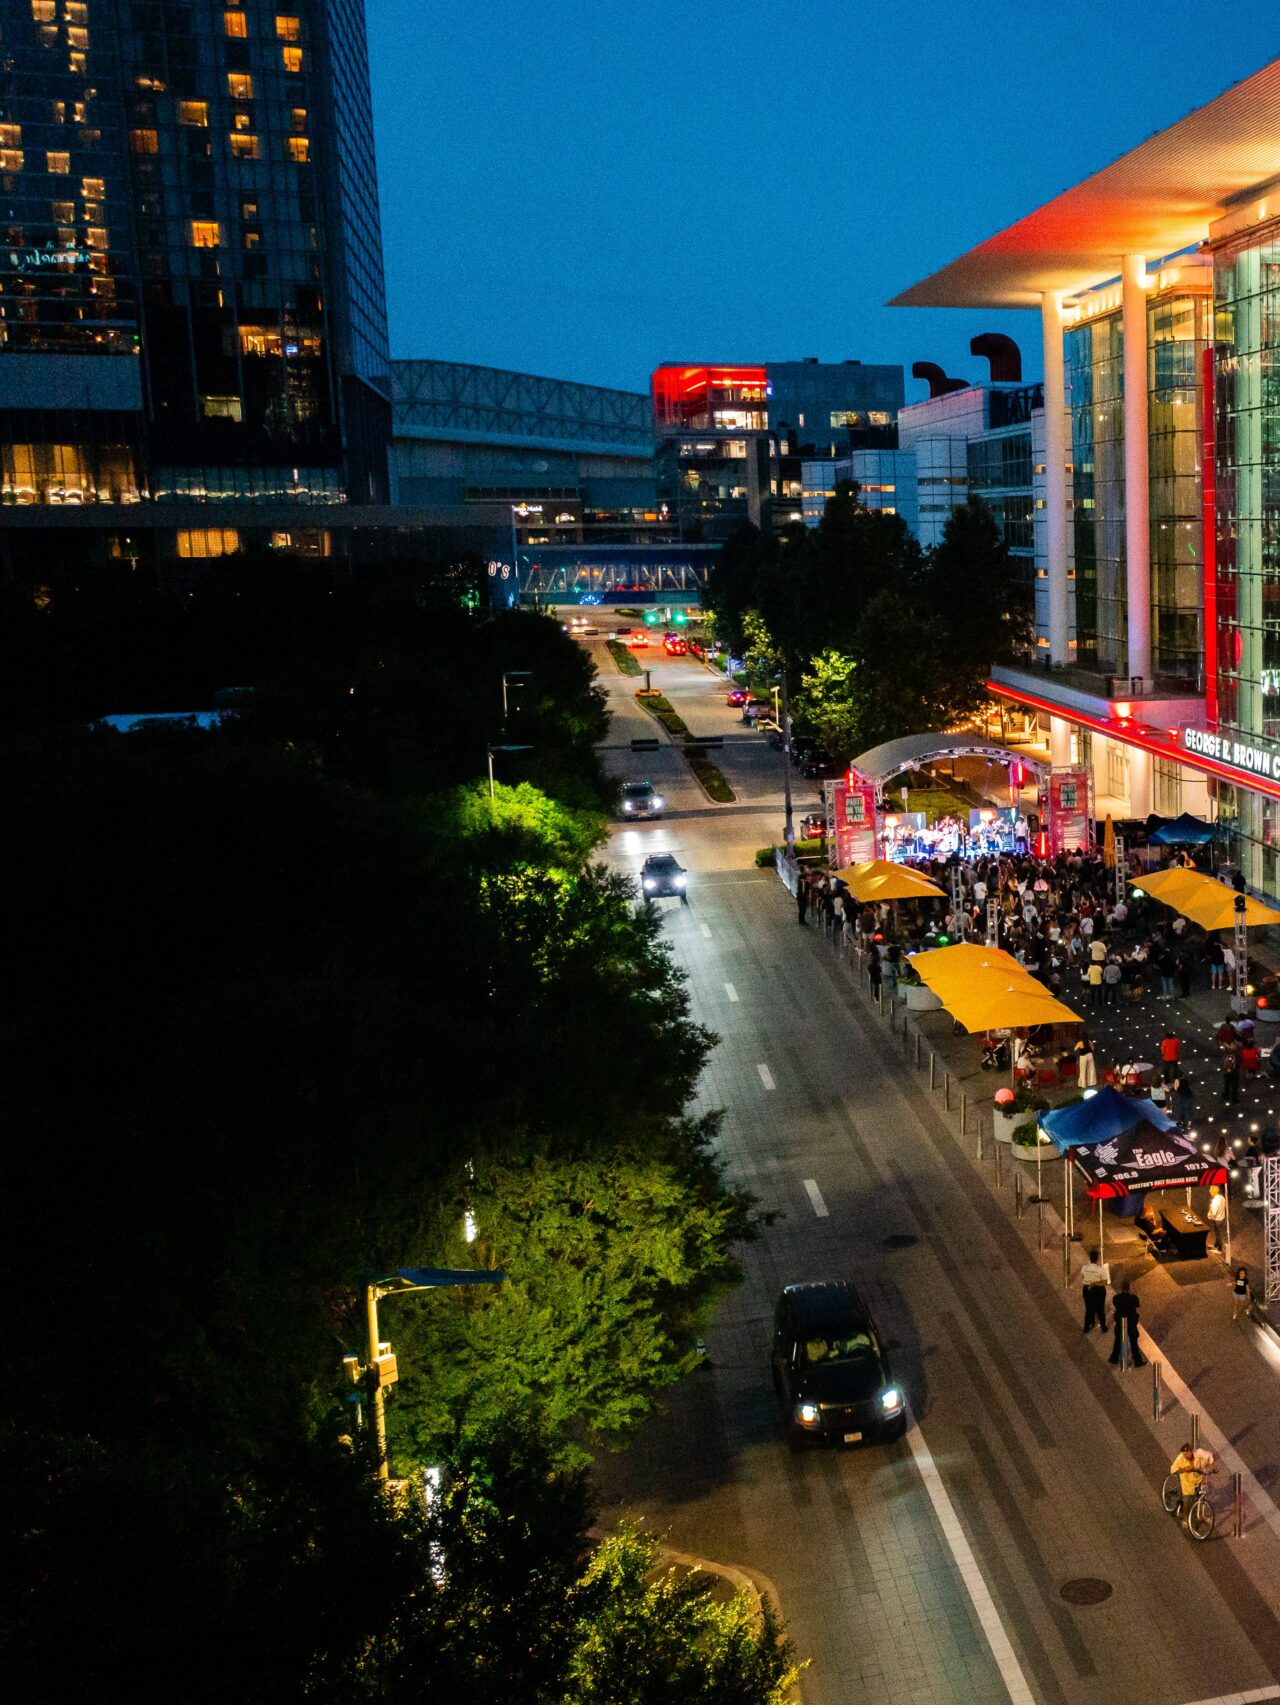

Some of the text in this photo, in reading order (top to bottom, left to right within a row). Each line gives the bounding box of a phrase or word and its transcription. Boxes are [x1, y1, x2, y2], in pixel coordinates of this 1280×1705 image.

[1185, 728, 1221, 757] GEORGE
[1222, 739, 1231, 761] R.
[1233, 742, 1270, 774] BROWN
[1135, 1149, 1176, 1167] Eagle
[1113, 1171, 1139, 1181] 106.9
